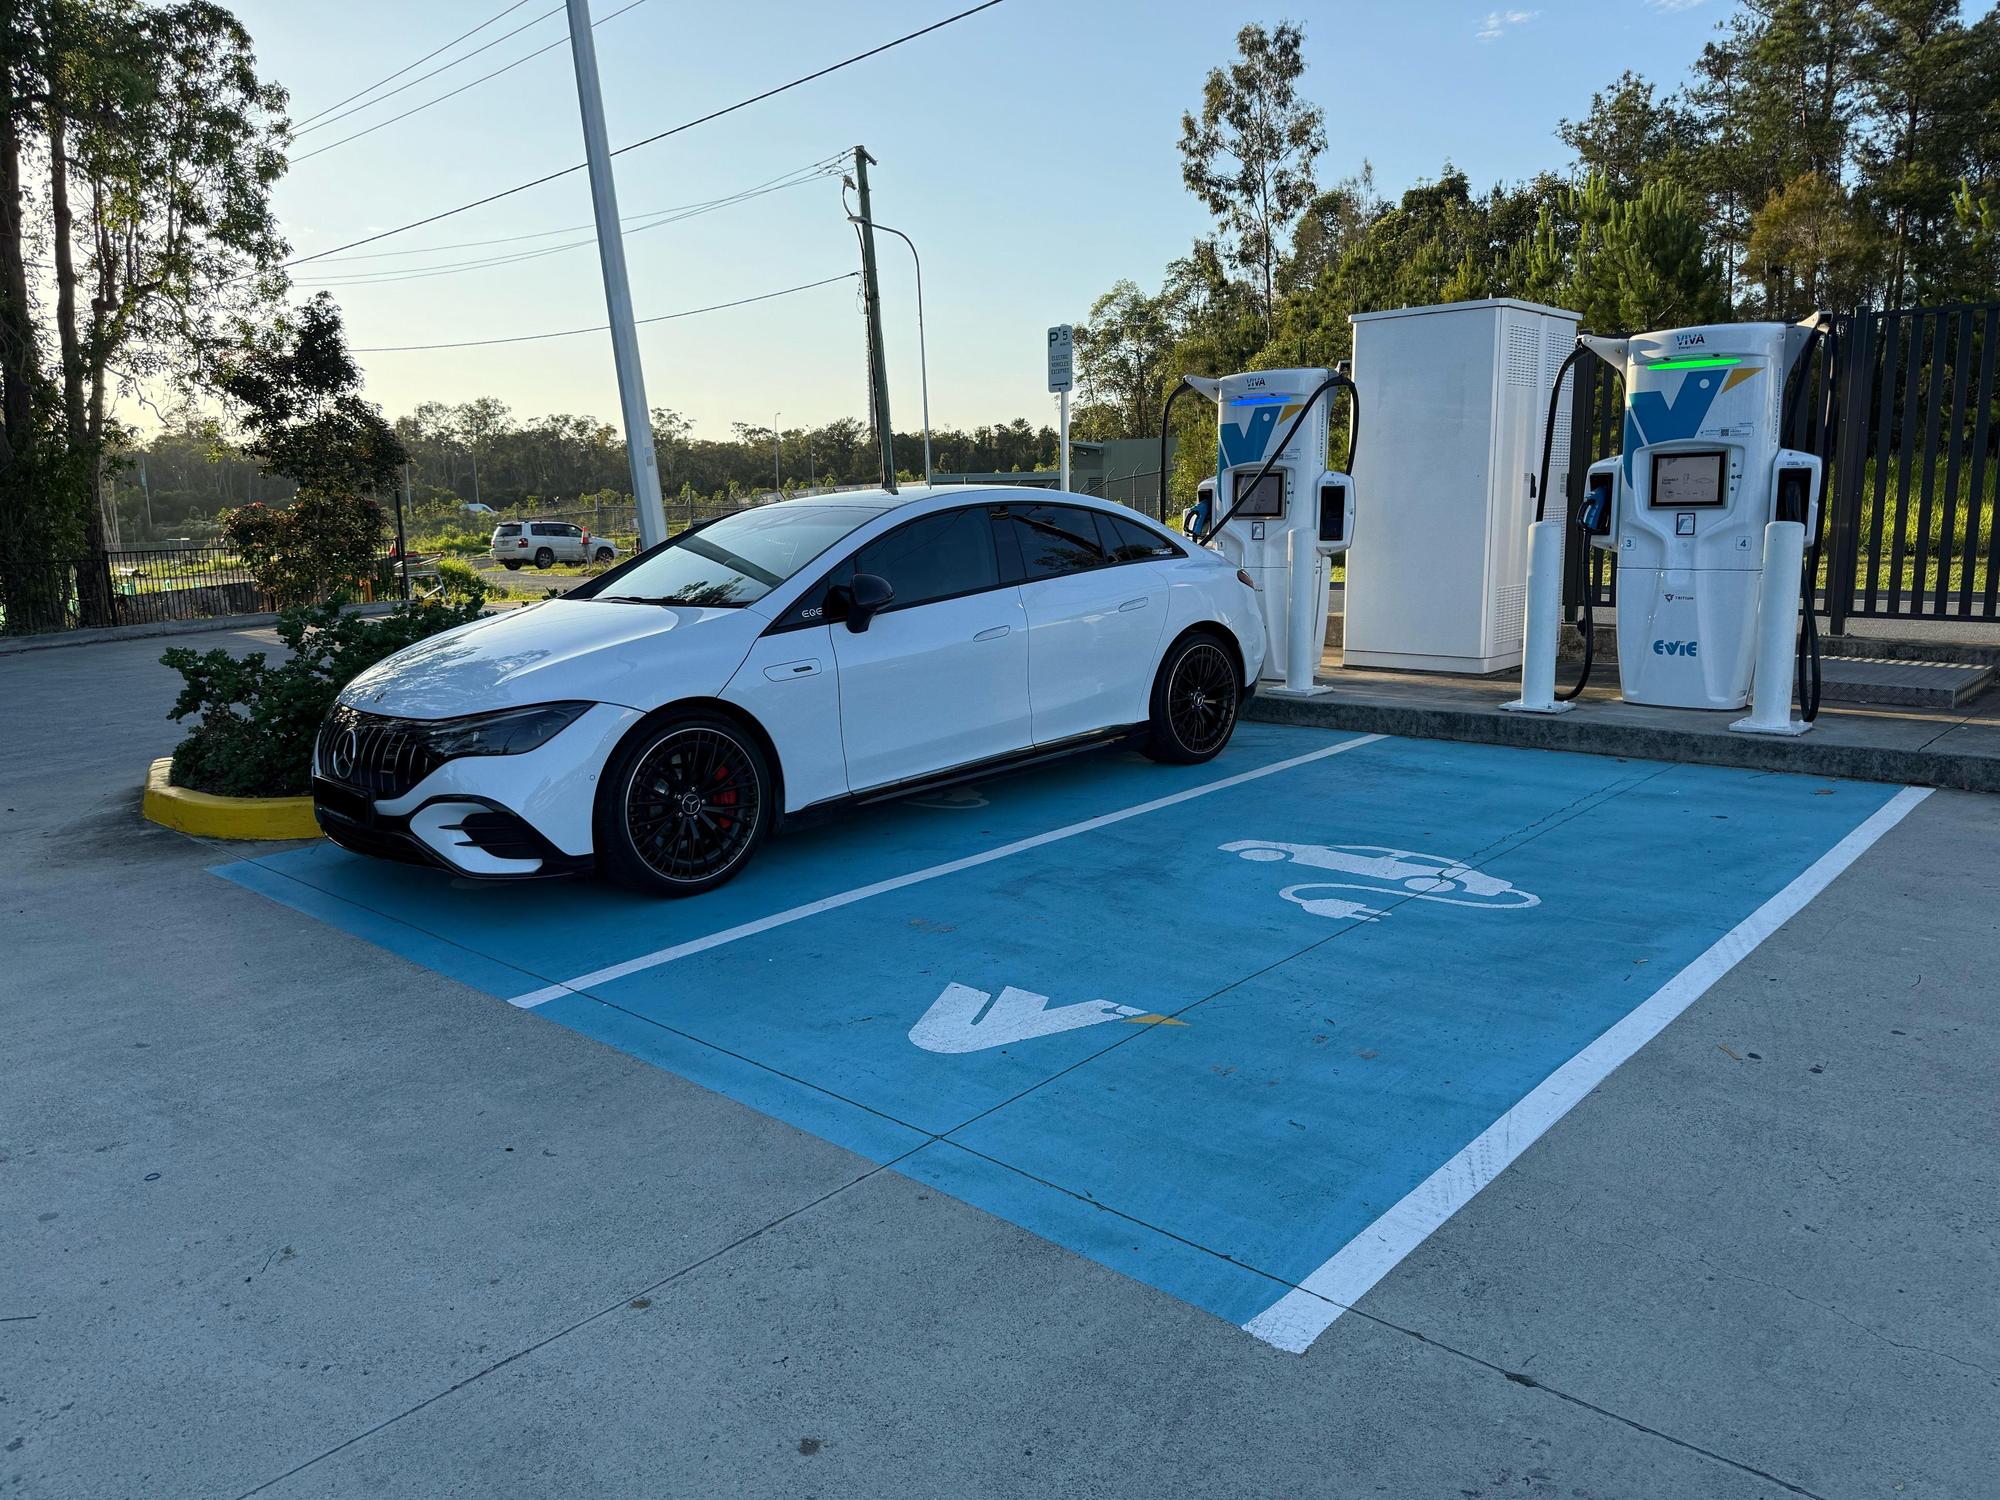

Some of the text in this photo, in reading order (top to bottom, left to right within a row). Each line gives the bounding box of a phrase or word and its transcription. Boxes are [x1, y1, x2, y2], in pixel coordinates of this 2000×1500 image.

[1050, 330, 1068, 347] P 5
[1676, 333, 1705, 346] VIVA
[1246, 377, 1266, 387] VIVA
[1626, 540, 1632, 548] 3
[1740, 540, 1747, 548] 4
[802, 607, 823, 618] EQE
